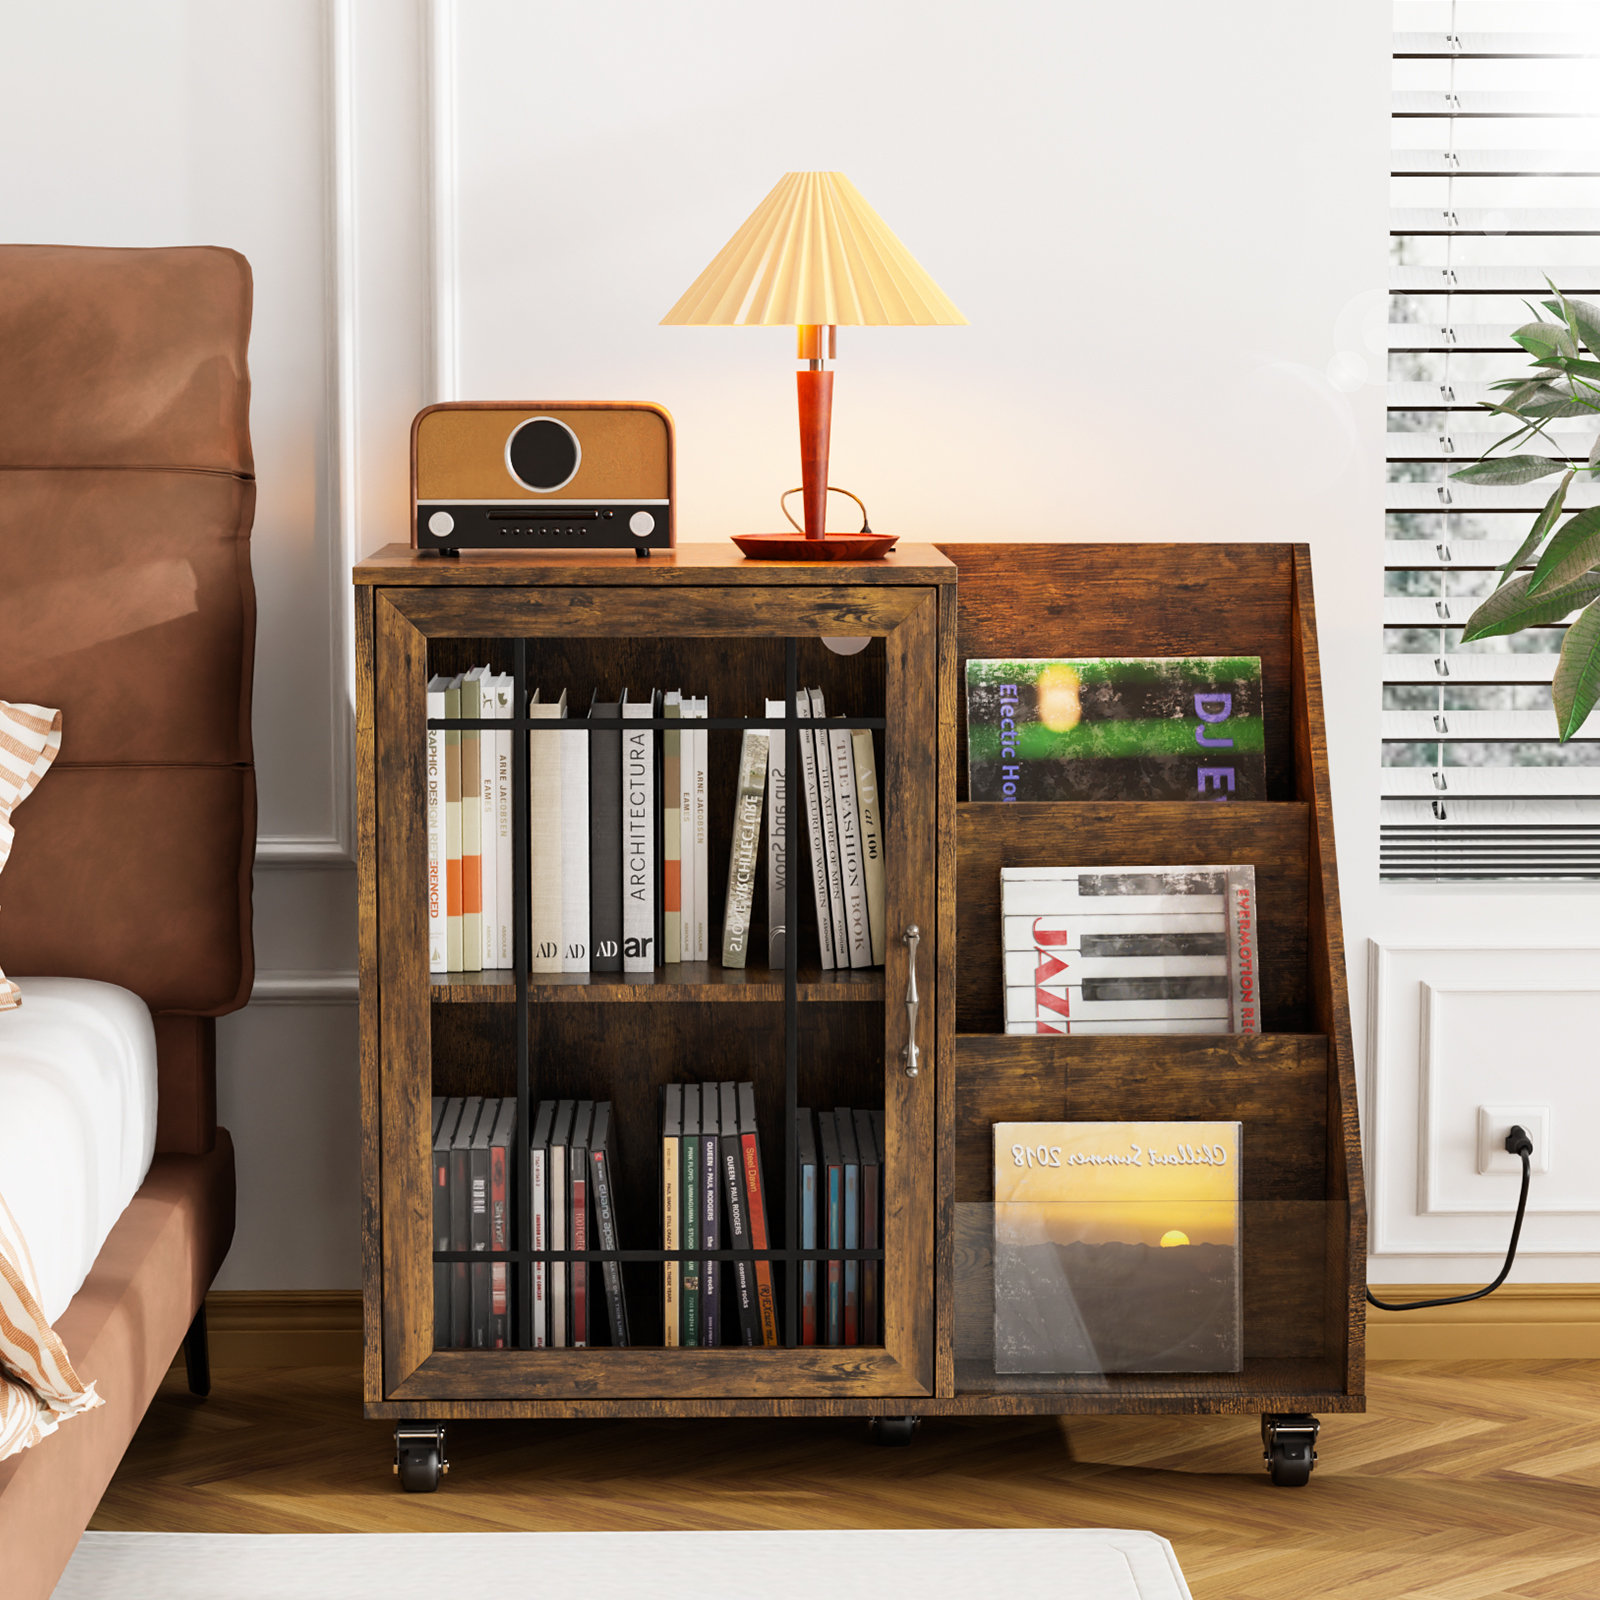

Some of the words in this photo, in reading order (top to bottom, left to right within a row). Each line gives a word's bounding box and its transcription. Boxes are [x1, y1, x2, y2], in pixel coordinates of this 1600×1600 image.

[999, 684, 1021, 759] Electic
[1194, 692, 1234, 748] DJ
[427, 717, 439, 777] RAPHIC
[499, 754, 508, 782] ARNE
[806, 755, 815, 780] THE
[836, 739, 850, 788] THE
[483, 778, 492, 813] EAMES
[696, 769, 705, 795] ARNE
[860, 764, 875, 804] AD
[1196, 766, 1236, 801] E
[428, 780, 439, 829] DESIGN
[499, 784, 508, 838] JACOBSEN
[629, 732, 647, 901] ARCHITECTURA
[683, 791, 691, 823] EAMES
[808, 783, 820, 835] ALLURE
[865, 808, 874, 826] at
[841, 793, 860, 887] FASHION
[867, 833, 879, 860] 100
[429, 832, 440, 919] REFERENCED
[815, 857, 827, 908] WOMEN
[831, 869, 841, 900] MEN
[850, 894, 865, 951] BOOK
[536, 942, 558, 958] AD
[565, 943, 586, 959] AD
[596, 941, 618, 958] AD
[624, 936, 654, 958] ar
[1237, 888, 1255, 1003] EVERMOTION
[706, 1141, 714, 1167] QUEEN
[726, 1155, 737, 1181] QUEEN
[746, 1147, 755, 1168] Steel
[730, 1186, 738, 1204] PAUL
[748, 1169, 758, 1193] Dawn
[731, 1203, 742, 1236] RODGERS
[707, 1276, 715, 1295] rocks
[738, 1262, 747, 1289] cosmos
[741, 1290, 750, 1309] rocks
